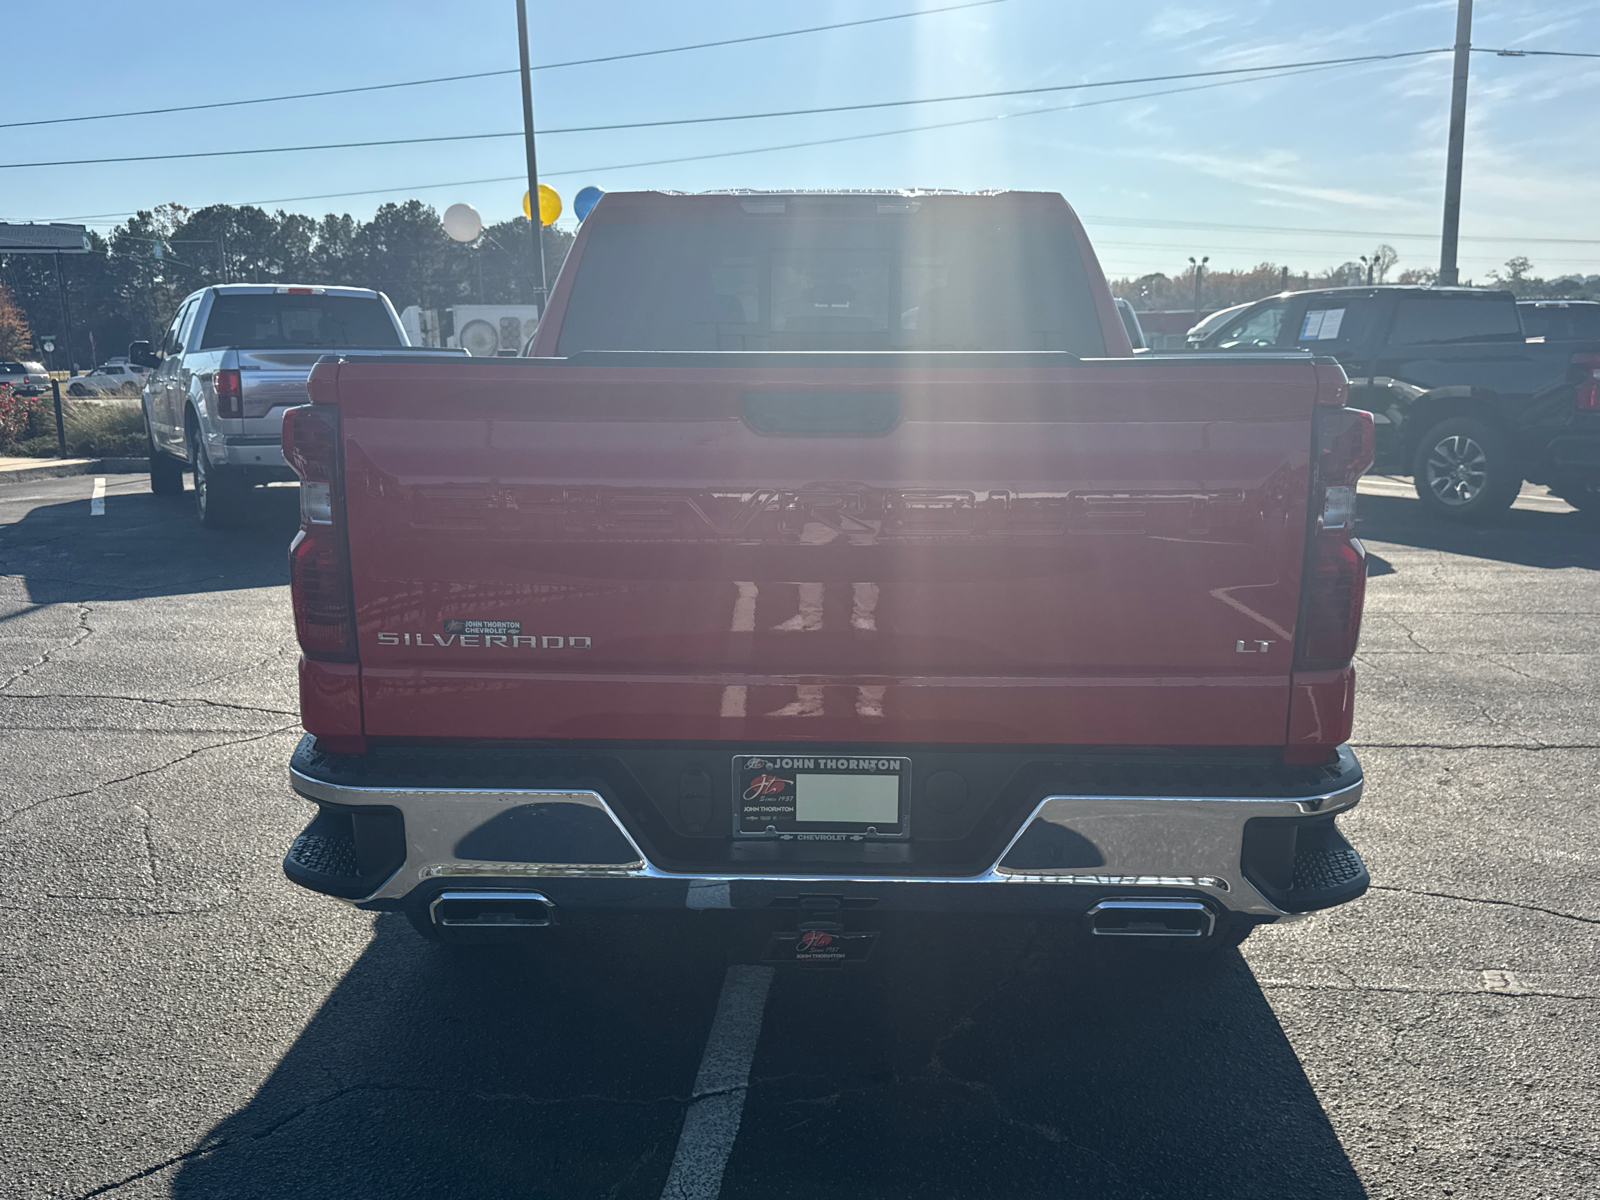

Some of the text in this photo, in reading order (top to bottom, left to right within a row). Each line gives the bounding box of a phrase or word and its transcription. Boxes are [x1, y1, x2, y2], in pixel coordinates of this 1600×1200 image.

[408, 487, 1246, 535] CHEVROLET
[465, 620, 520, 629] JOHN THORNTON
[377, 632, 592, 650] SILVERADO
[1236, 639, 1276, 653] LT
[775, 758, 814, 770] JOHN
[818, 759, 900, 771] THORNTON
